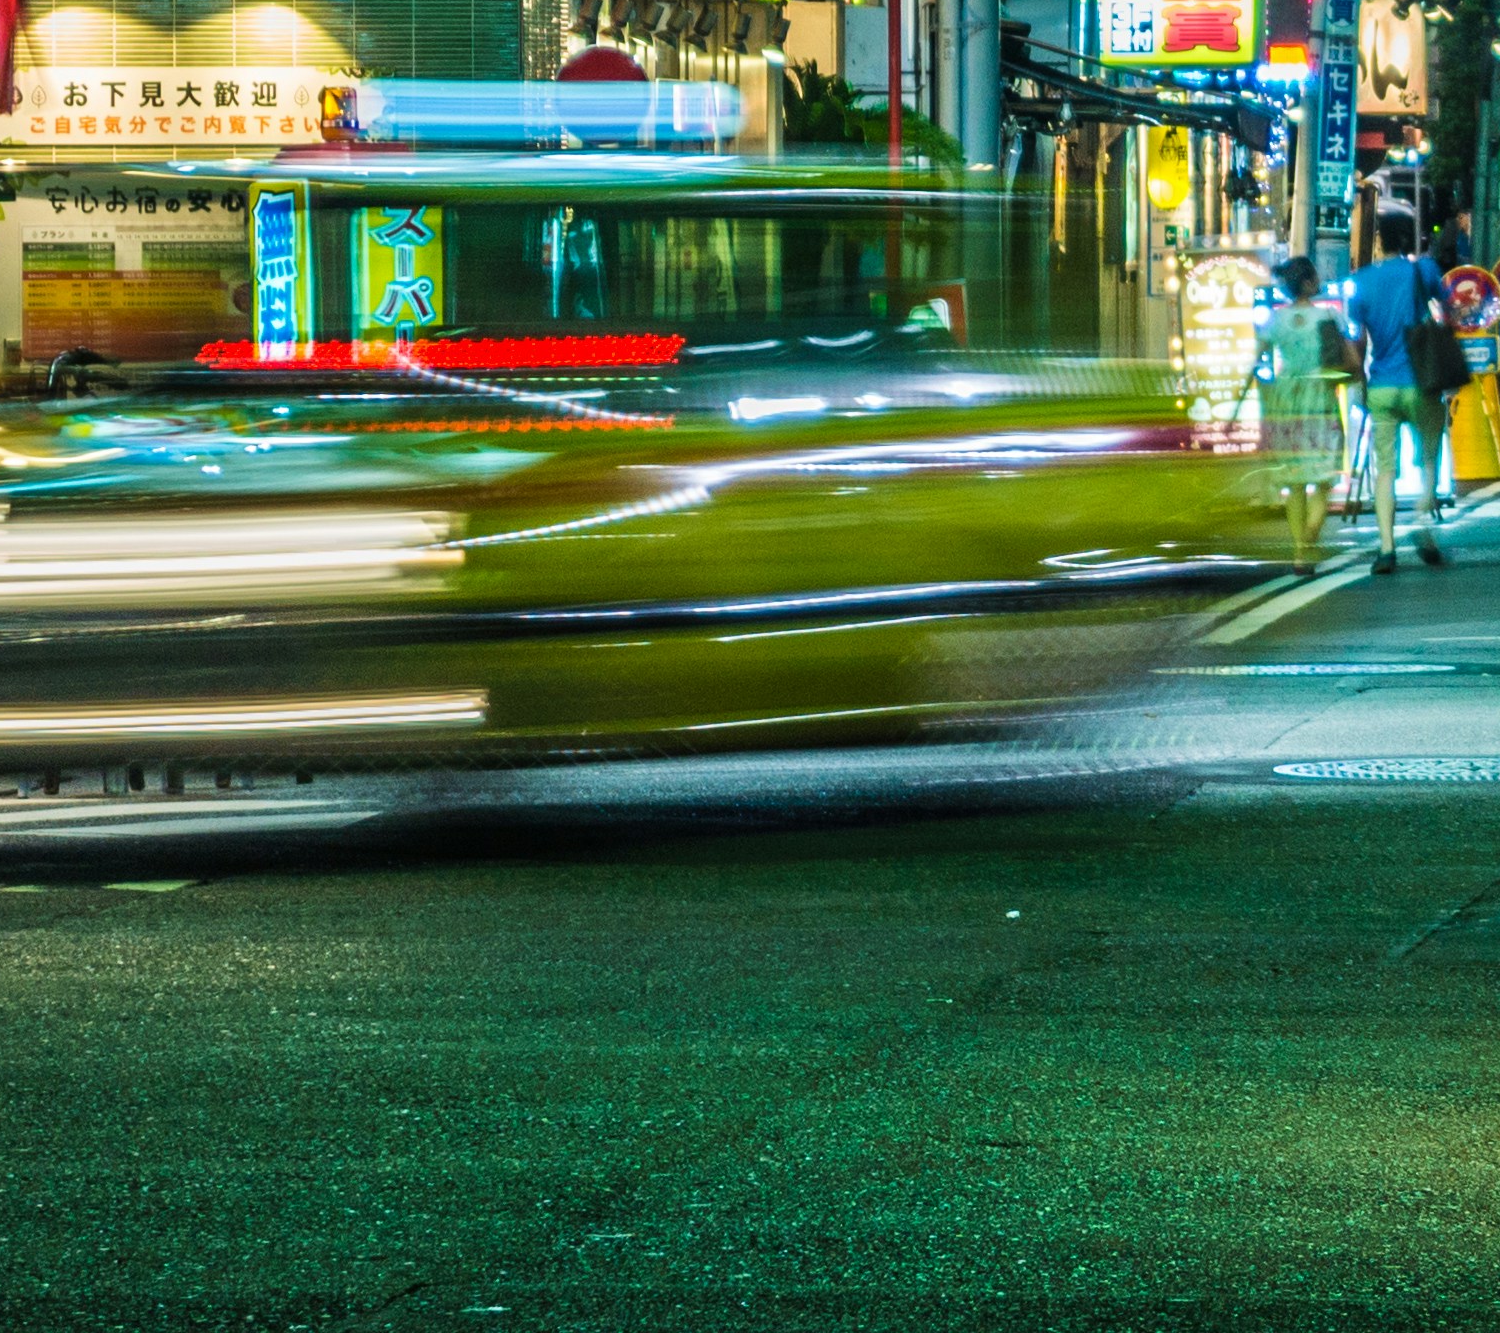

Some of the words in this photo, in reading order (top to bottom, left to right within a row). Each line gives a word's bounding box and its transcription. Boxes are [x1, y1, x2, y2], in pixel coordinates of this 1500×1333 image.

[62, 80, 278, 109] お下見大歓迎
[30, 115, 322, 136] ご自宅気分でご内覧下さい
[1325, 66, 1350, 161] セキネ
[44, 185, 247, 216] 安心お宿の安心
